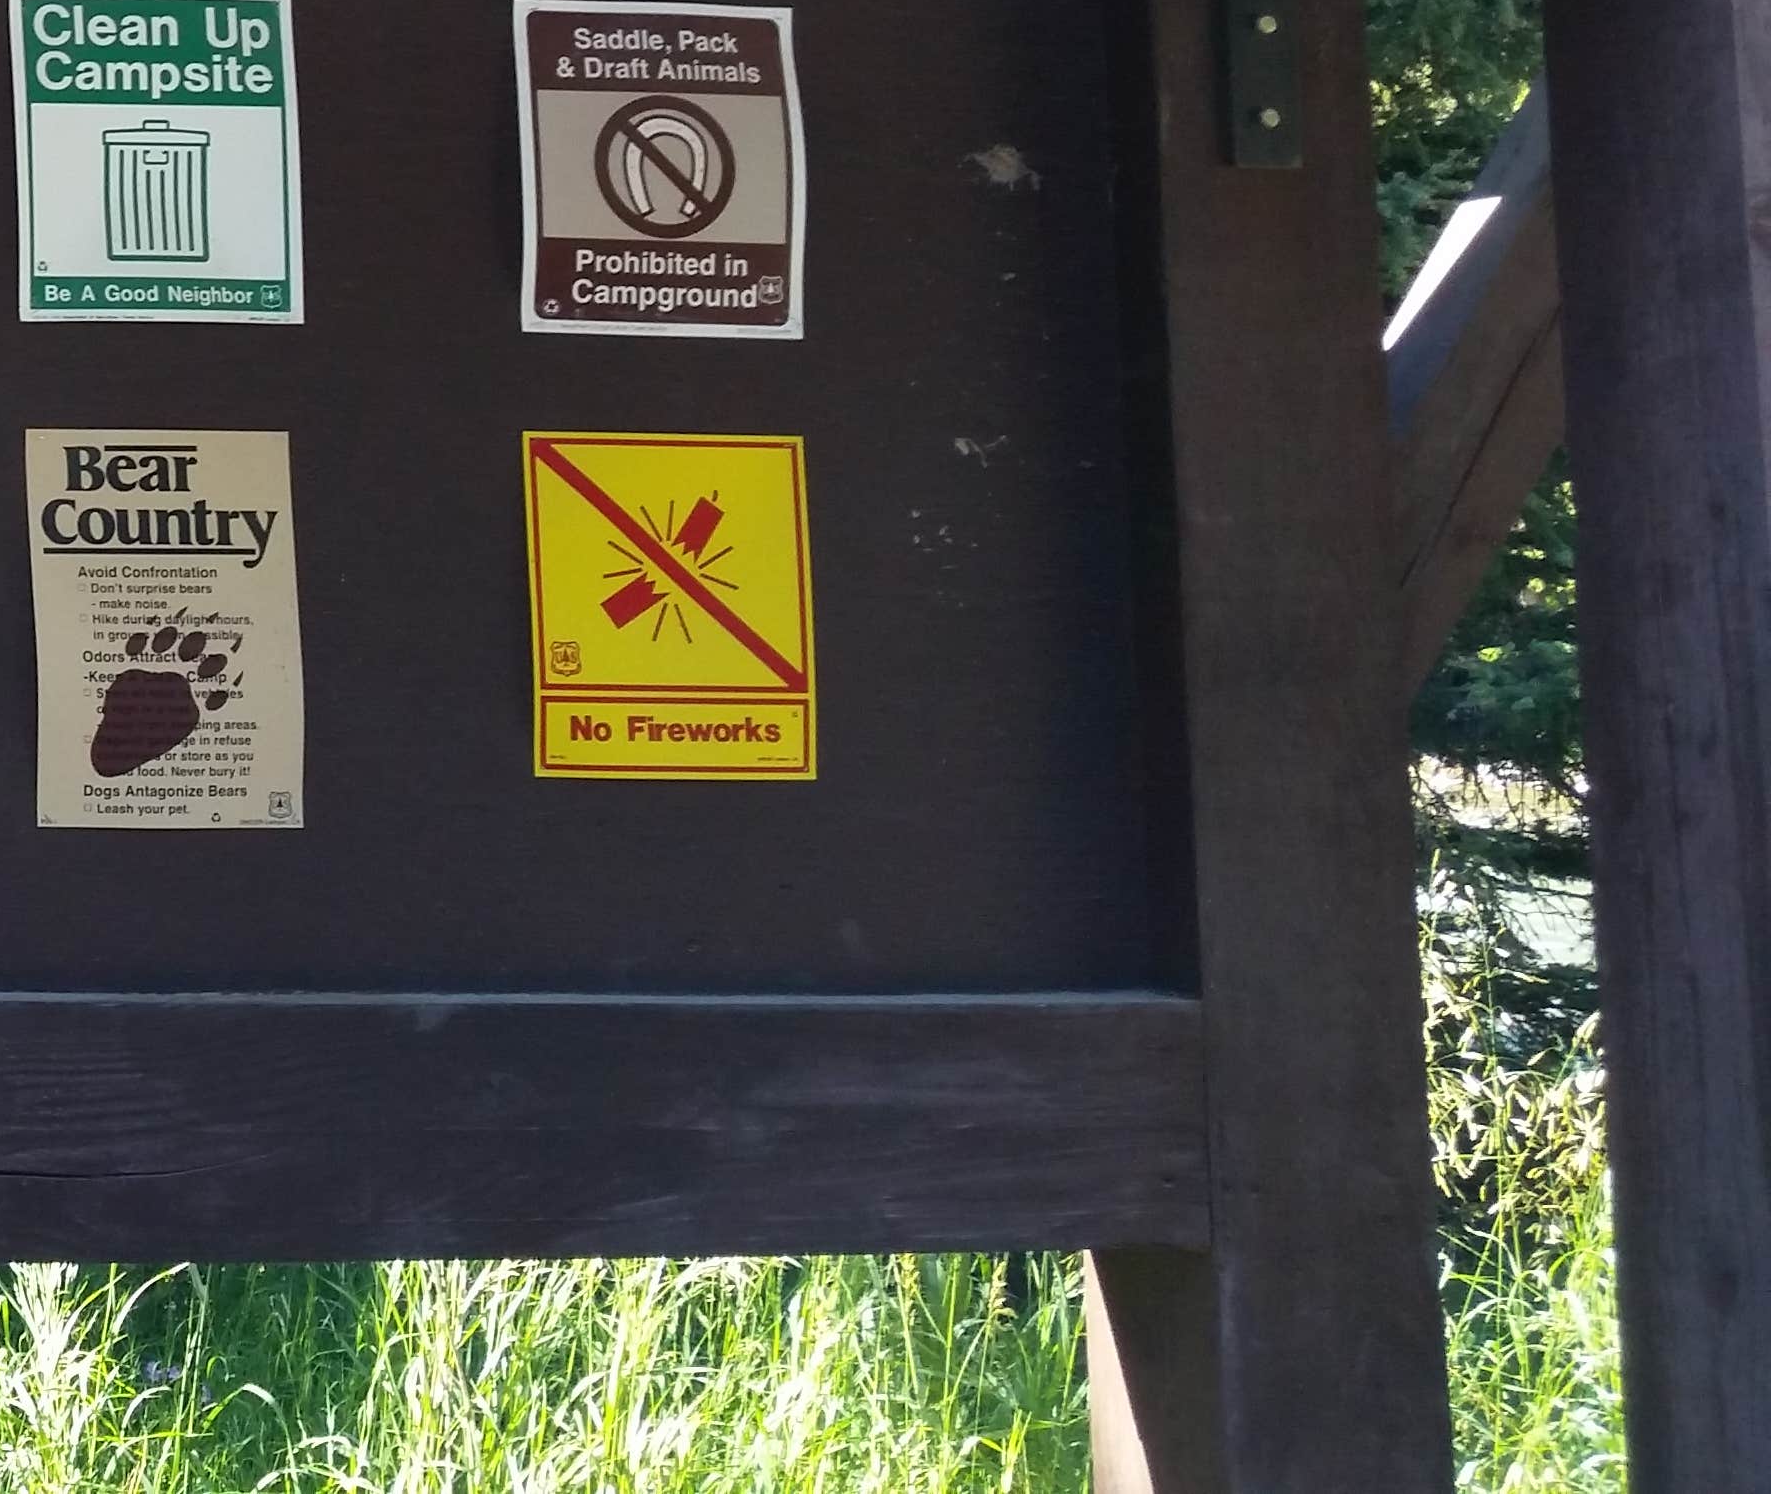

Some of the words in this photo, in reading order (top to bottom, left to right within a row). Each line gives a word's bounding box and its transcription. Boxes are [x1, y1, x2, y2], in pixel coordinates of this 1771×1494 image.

[33, 4, 179, 46] Clean
[206, 6, 271, 57] Up
[574, 27, 672, 55] Saddle,
[679, 30, 738, 53] Pack
[36, 50, 274, 99] Campsite
[557, 58, 576, 78] &
[585, 58, 650, 80] Draft
[658, 59, 760, 83] Animals
[576, 249, 716, 276] Prohibited
[725, 253, 748, 276] in
[45, 285, 71, 302] Be
[81, 286, 95, 302] A
[105, 285, 158, 302] Good
[168, 286, 254, 306] Neighbor
[572, 279, 758, 312] Campground
[63, 445, 198, 492] Bear
[41, 498, 279, 568] Country
[78, 566, 118, 578] Avoid
[121, 566, 218, 578] Confrontation
[570, 715, 612, 742] No
[628, 715, 780, 743] Fireworks
[84, 785, 121, 798] Dogs
[125, 785, 205, 799] Antagonize
[209, 786, 248, 798] Bears
